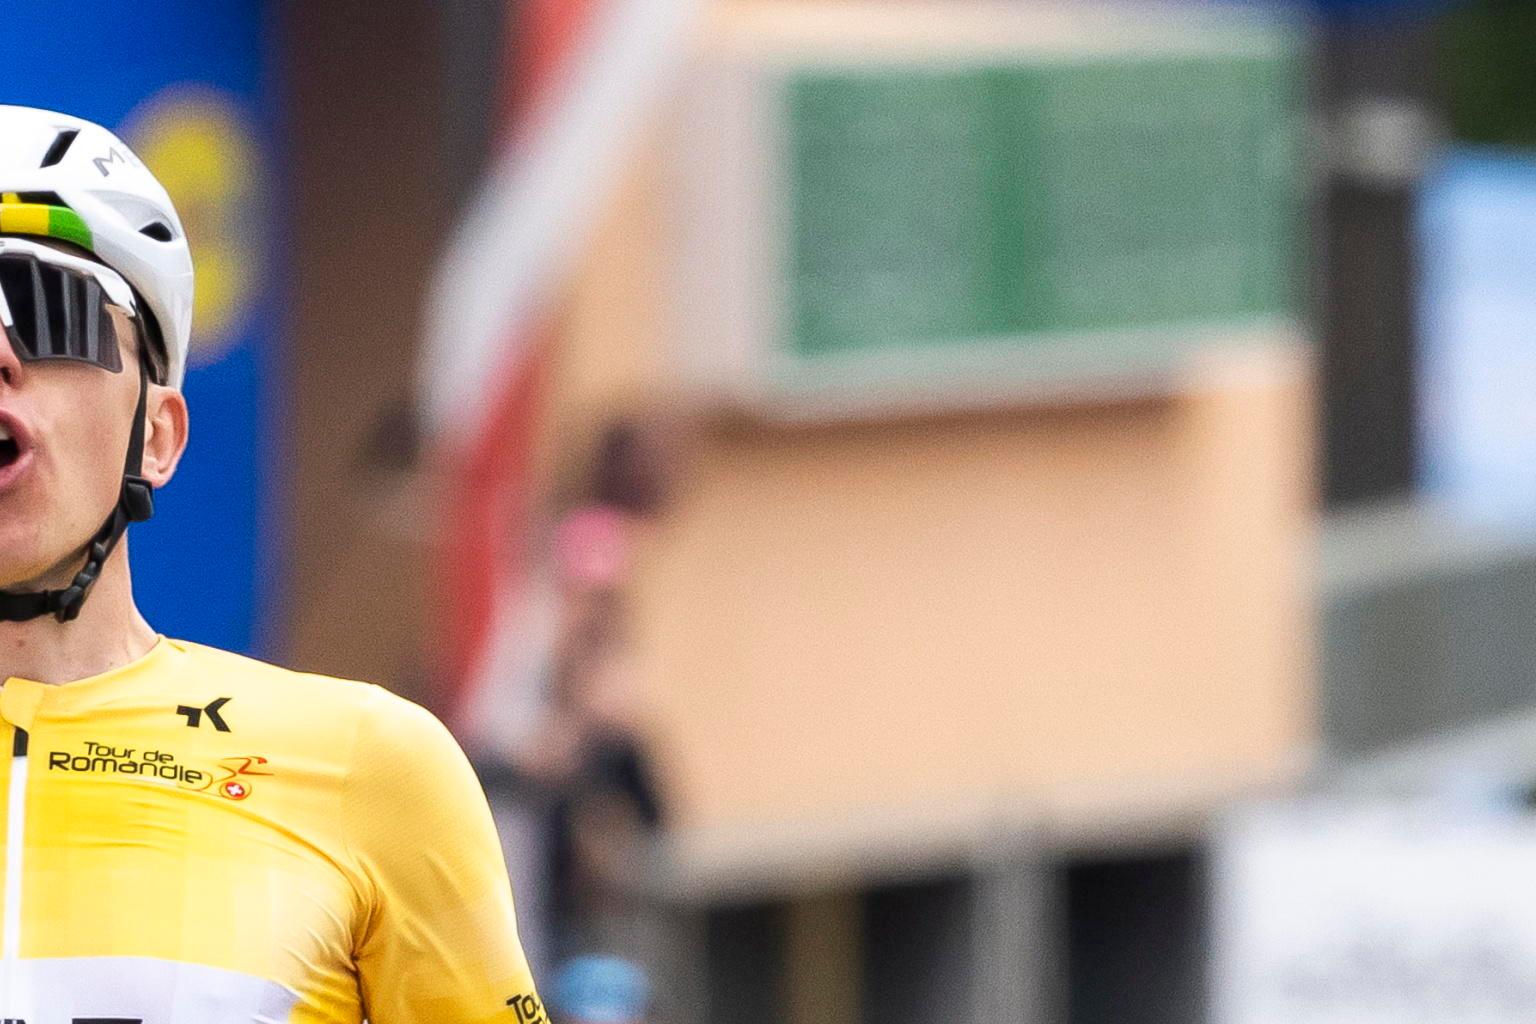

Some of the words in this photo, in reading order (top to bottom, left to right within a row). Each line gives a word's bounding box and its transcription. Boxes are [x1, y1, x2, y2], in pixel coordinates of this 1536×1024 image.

[83, 741, 136, 759] Tour
[143, 750, 174, 764] de
[48, 751, 203, 784] Romandie
